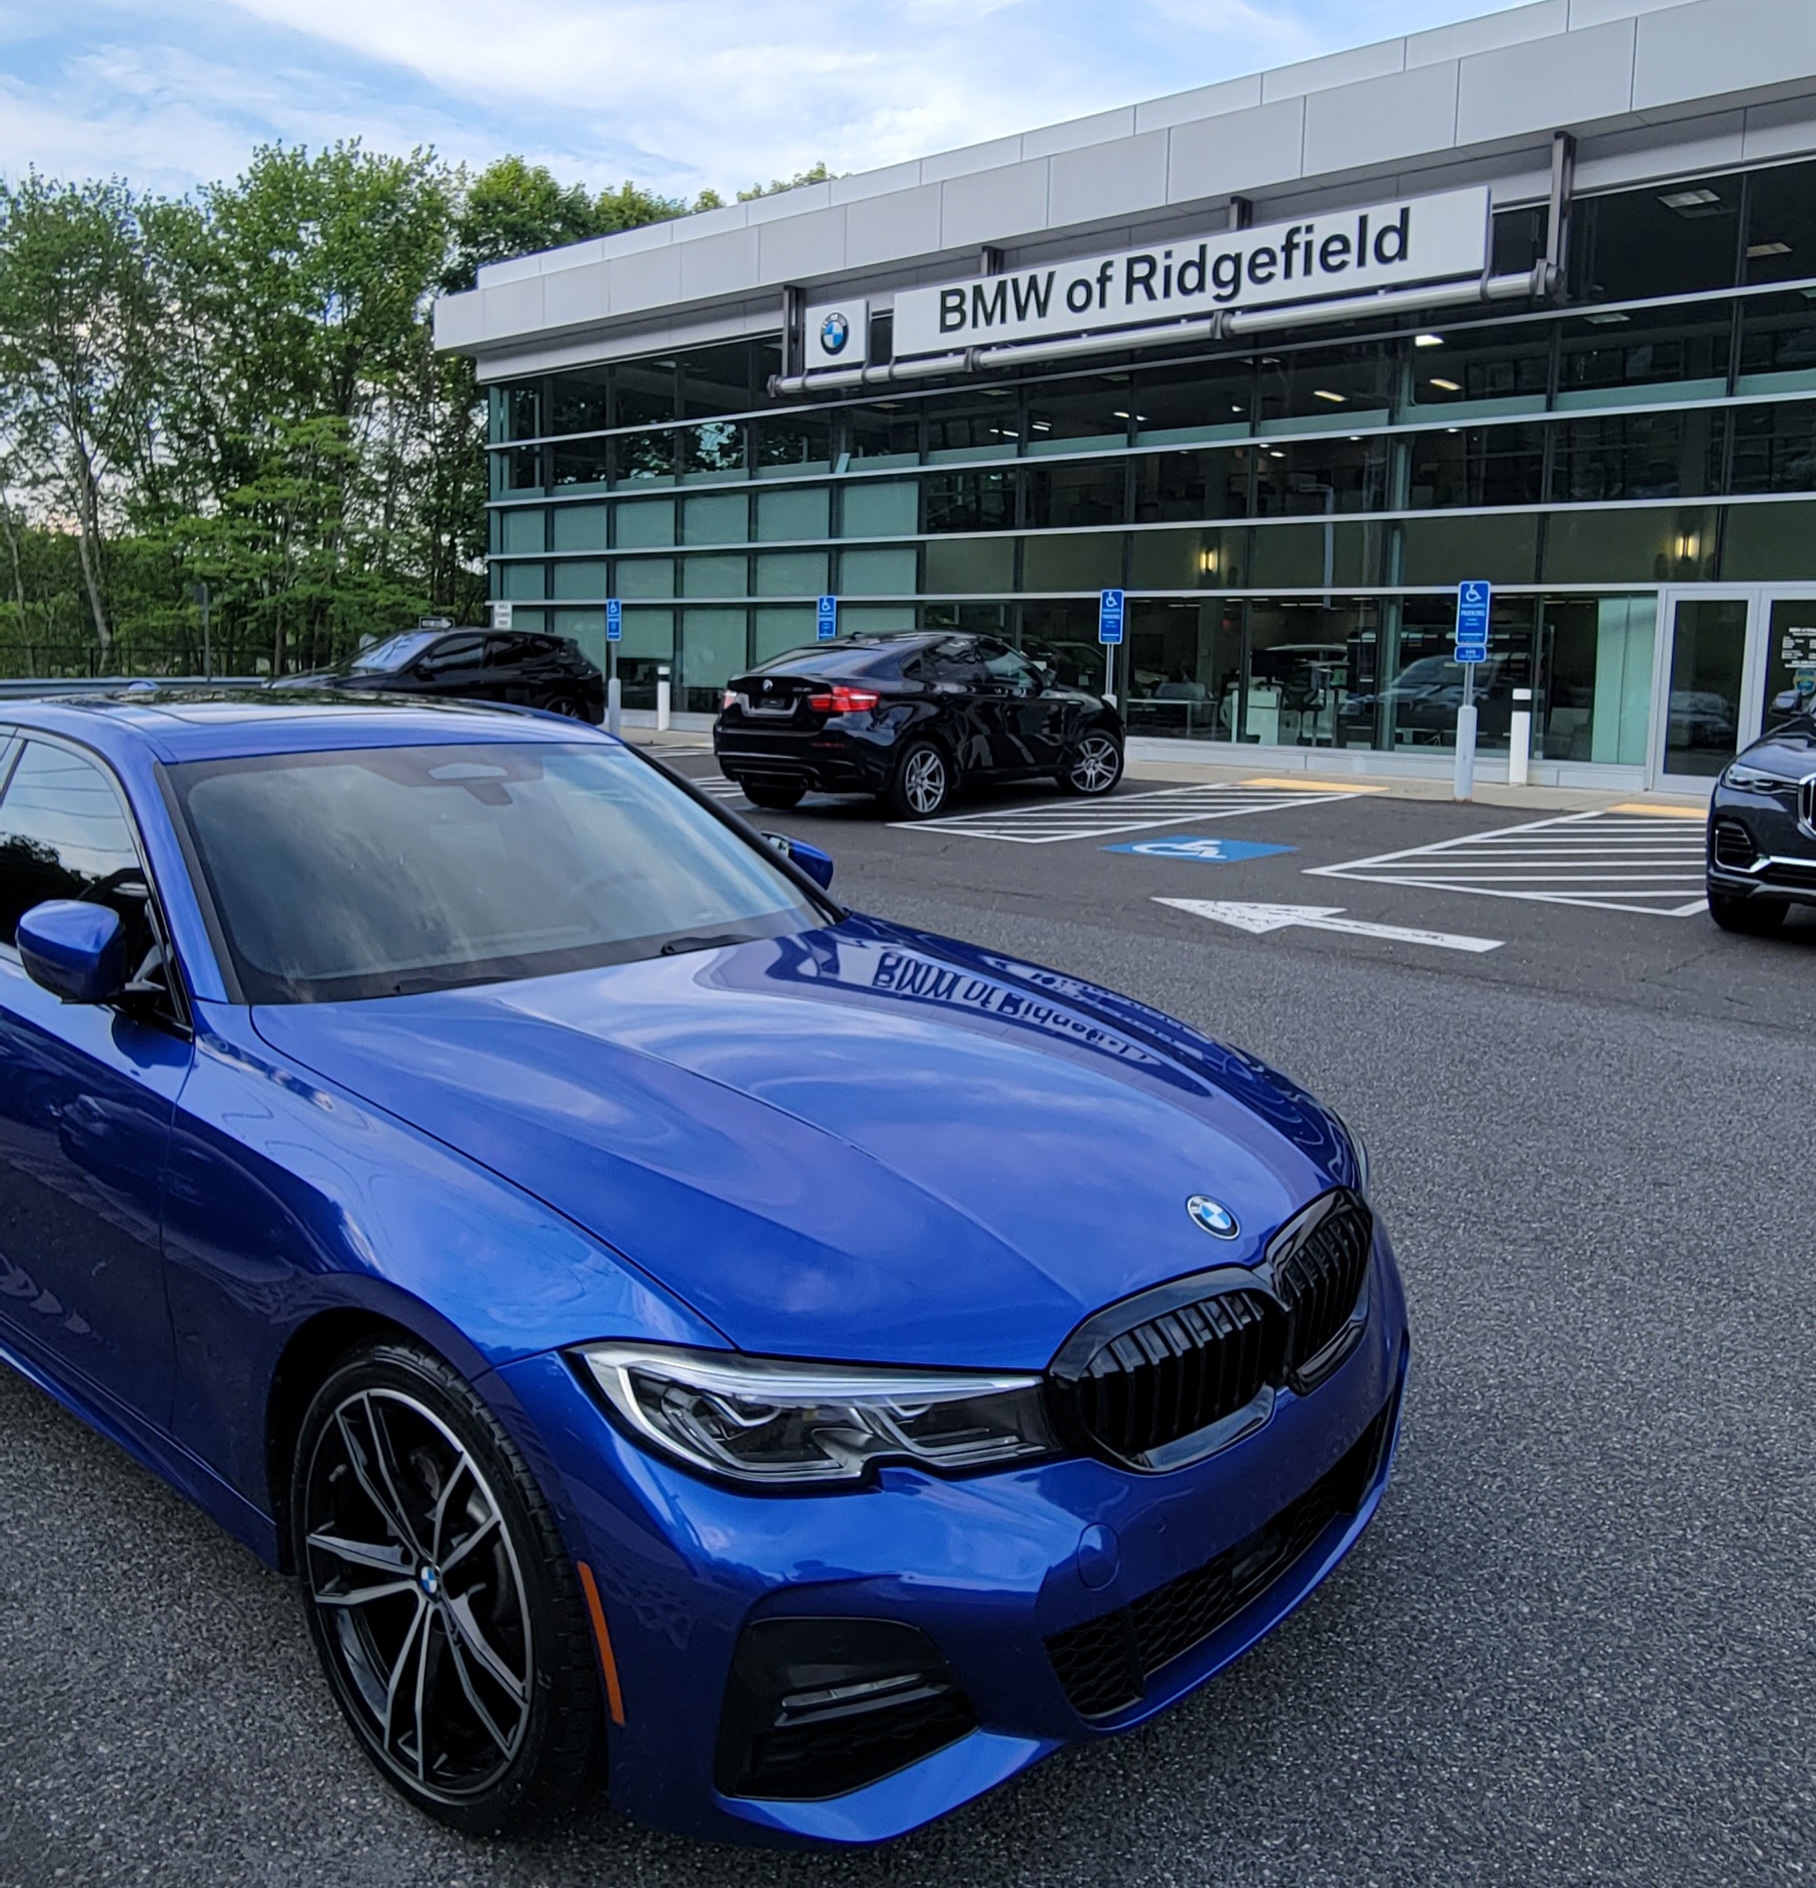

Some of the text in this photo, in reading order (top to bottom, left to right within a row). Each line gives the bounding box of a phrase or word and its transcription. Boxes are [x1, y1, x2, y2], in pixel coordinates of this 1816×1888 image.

[939, 206, 1410, 334] BMW of Ridgefield
